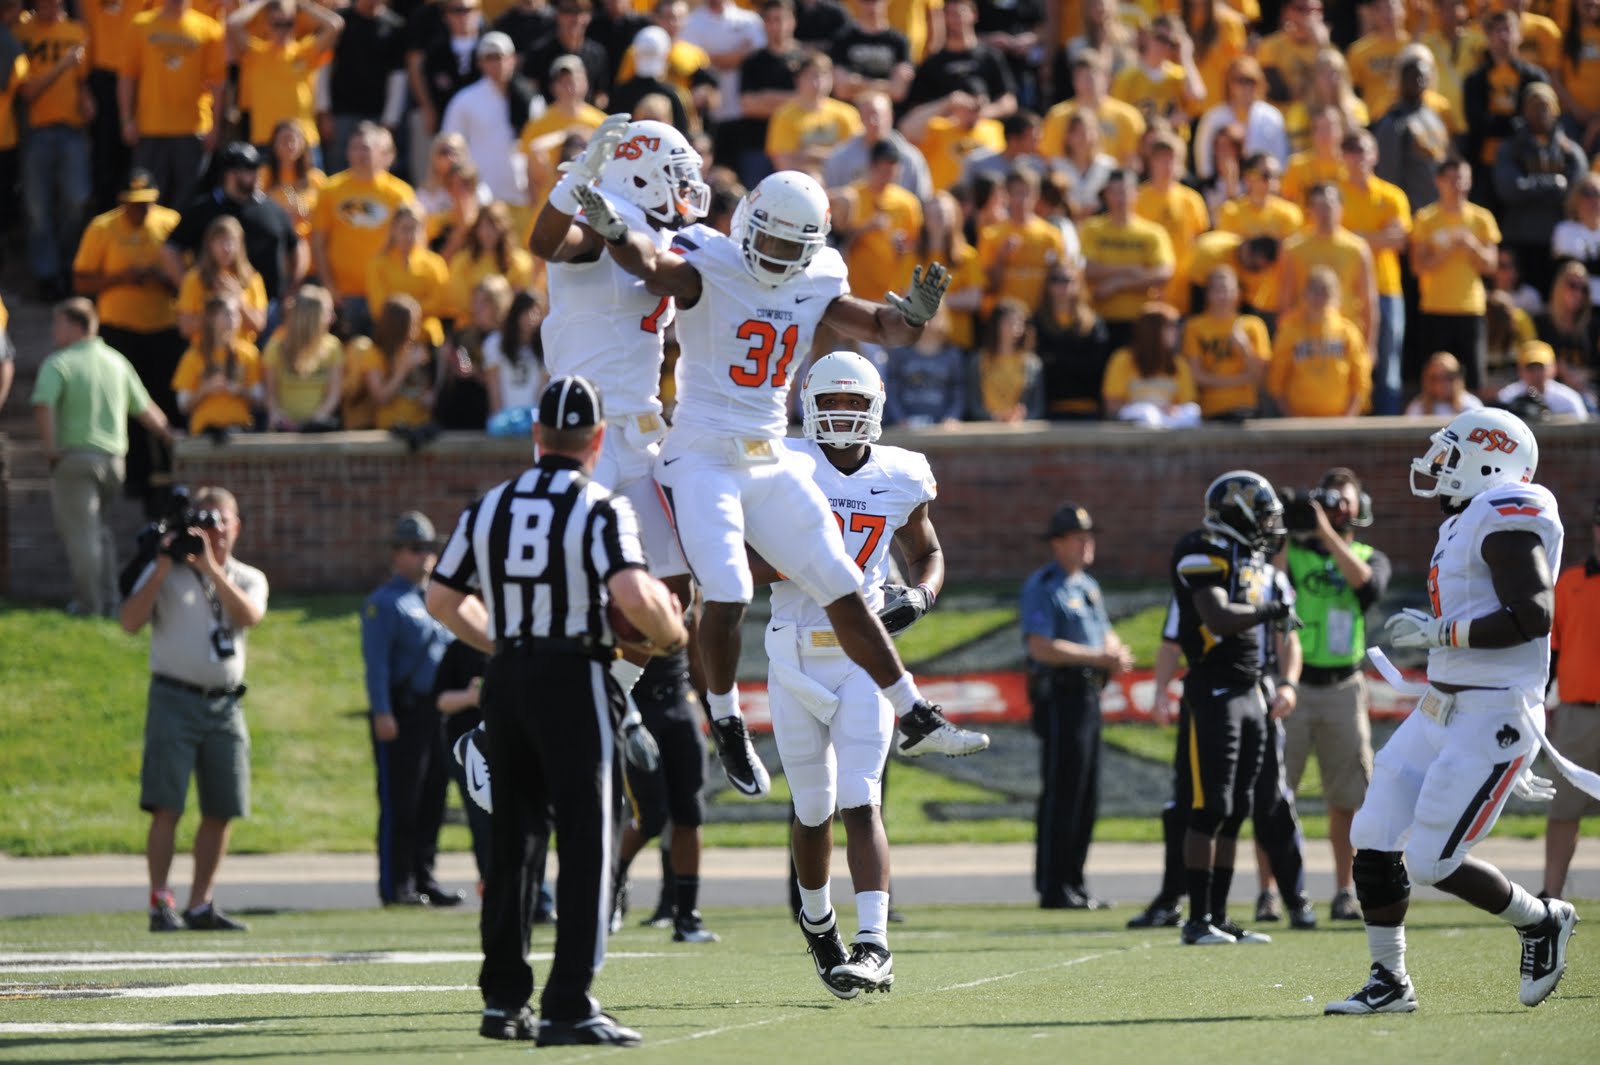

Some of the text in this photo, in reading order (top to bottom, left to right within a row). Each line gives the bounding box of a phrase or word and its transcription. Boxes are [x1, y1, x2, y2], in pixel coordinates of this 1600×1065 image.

[728, 318, 799, 388] 31
[1466, 427, 1519, 455] OSU
[828, 498, 867, 511] COWBOYS
[503, 497, 556, 577] B
